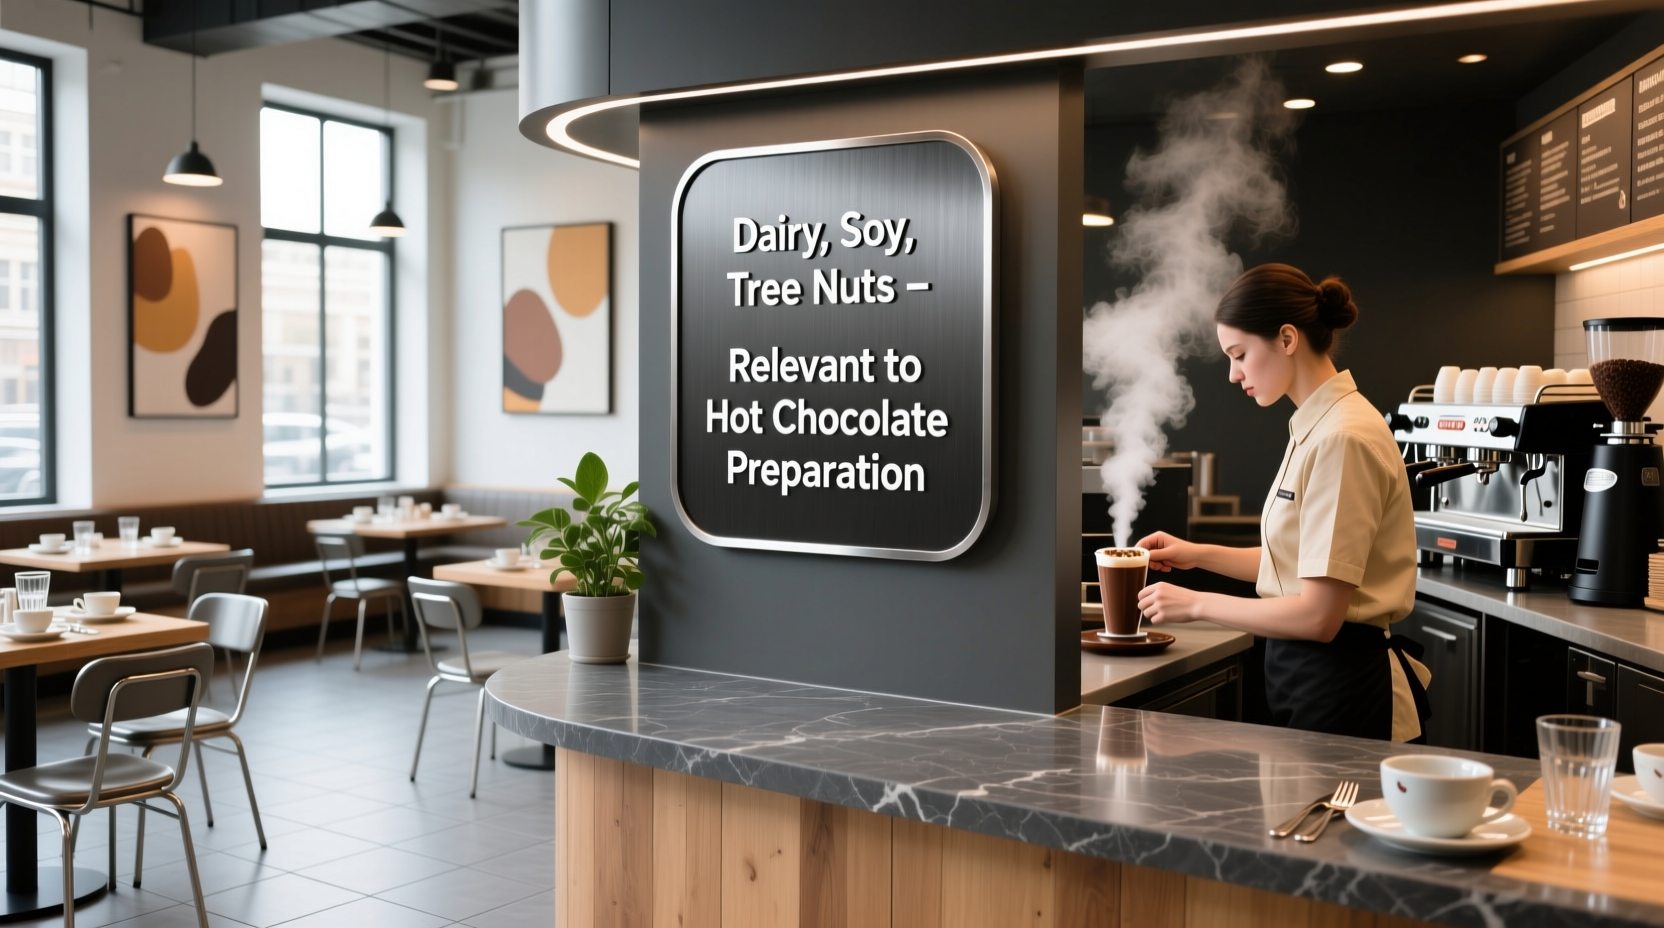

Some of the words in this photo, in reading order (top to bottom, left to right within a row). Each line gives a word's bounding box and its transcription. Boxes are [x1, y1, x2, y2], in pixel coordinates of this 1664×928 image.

[732, 213, 829, 259] Dairy,
[840, 210, 915, 256] Soy,
[726, 271, 802, 306] Tree
[813, 268, 896, 305] Nuts
[729, 346, 875, 383] Relevant
[883, 348, 922, 383] to
[706, 398, 763, 434] Hot
[772, 398, 949, 437] Chocolate
[727, 450, 925, 496] Preparation
